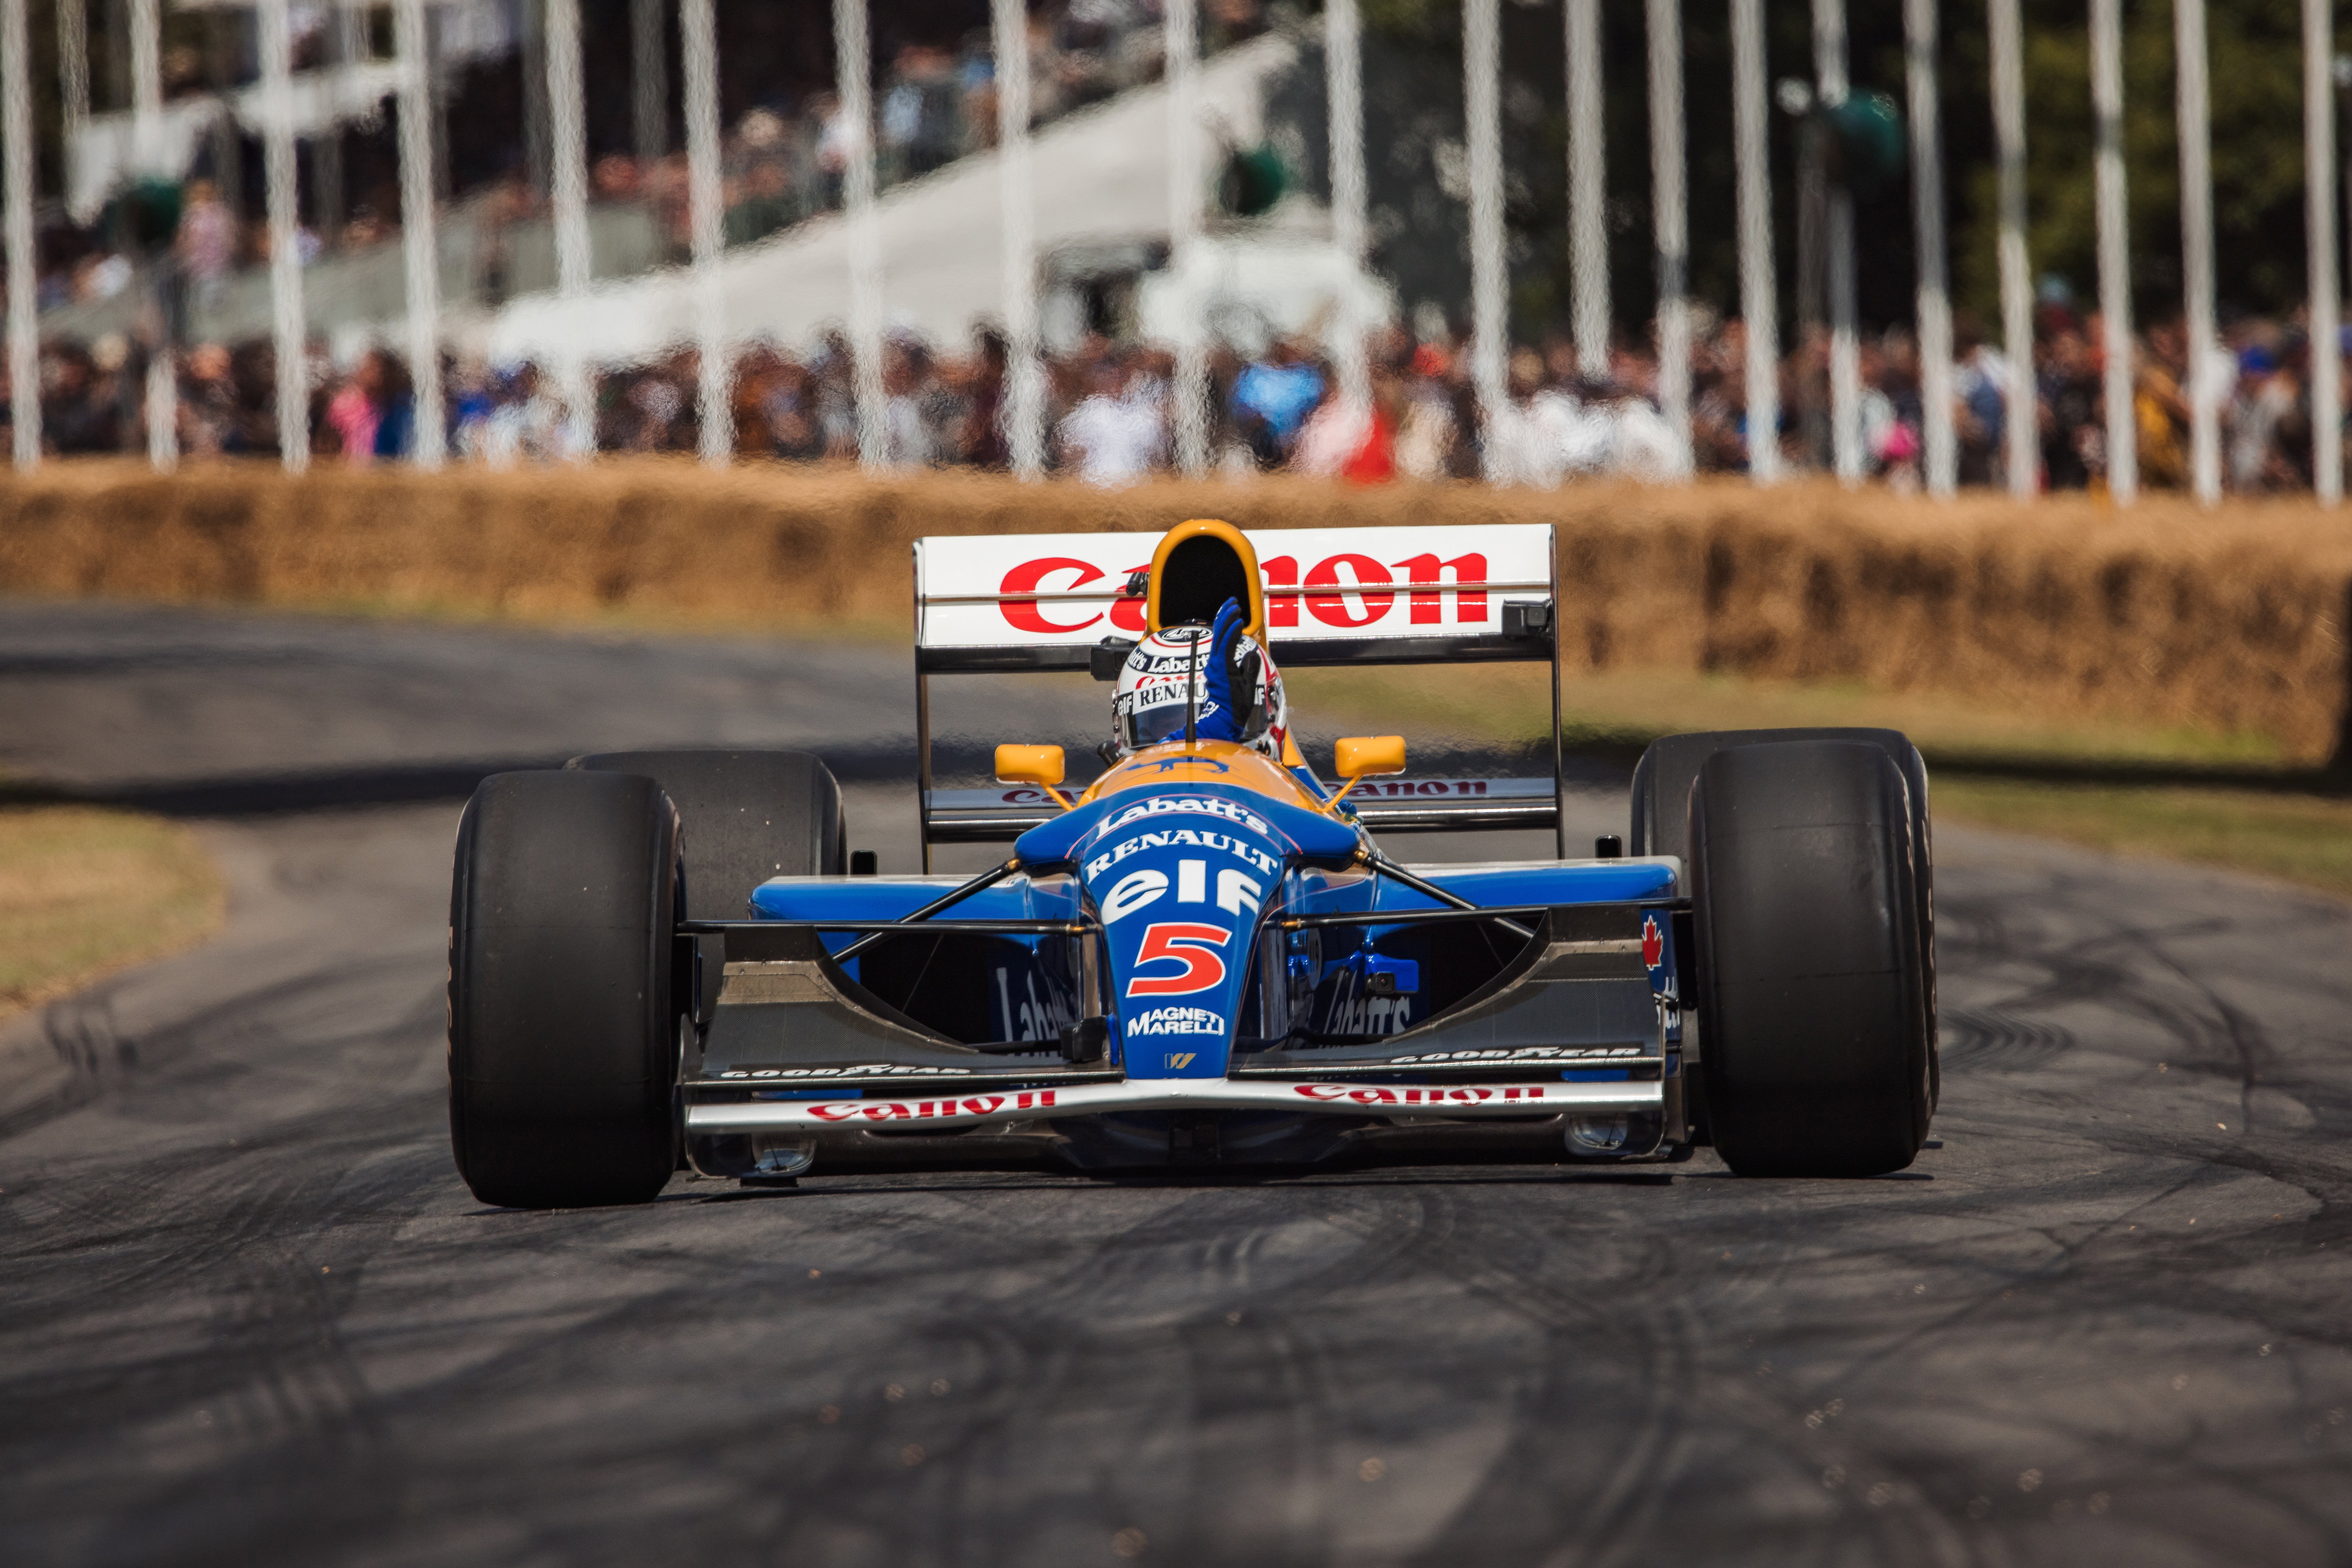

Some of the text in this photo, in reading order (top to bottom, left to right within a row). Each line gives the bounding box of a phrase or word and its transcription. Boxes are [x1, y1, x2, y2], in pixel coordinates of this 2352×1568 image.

[1117, 695, 1133, 716] elf
[1139, 681, 1206, 707] RENAU
[1253, 686, 1265, 705] lf
[1095, 798, 1267, 840] Labatt's
[1085, 829, 1278, 884] RENAULT
[1101, 859, 1262, 925] elf
[1125, 922, 1233, 998] 5
[1127, 1017, 1225, 1038] MARELLI
[807, 1090, 1055, 1121] Canon
[1293, 1084, 1544, 1107] Canon
